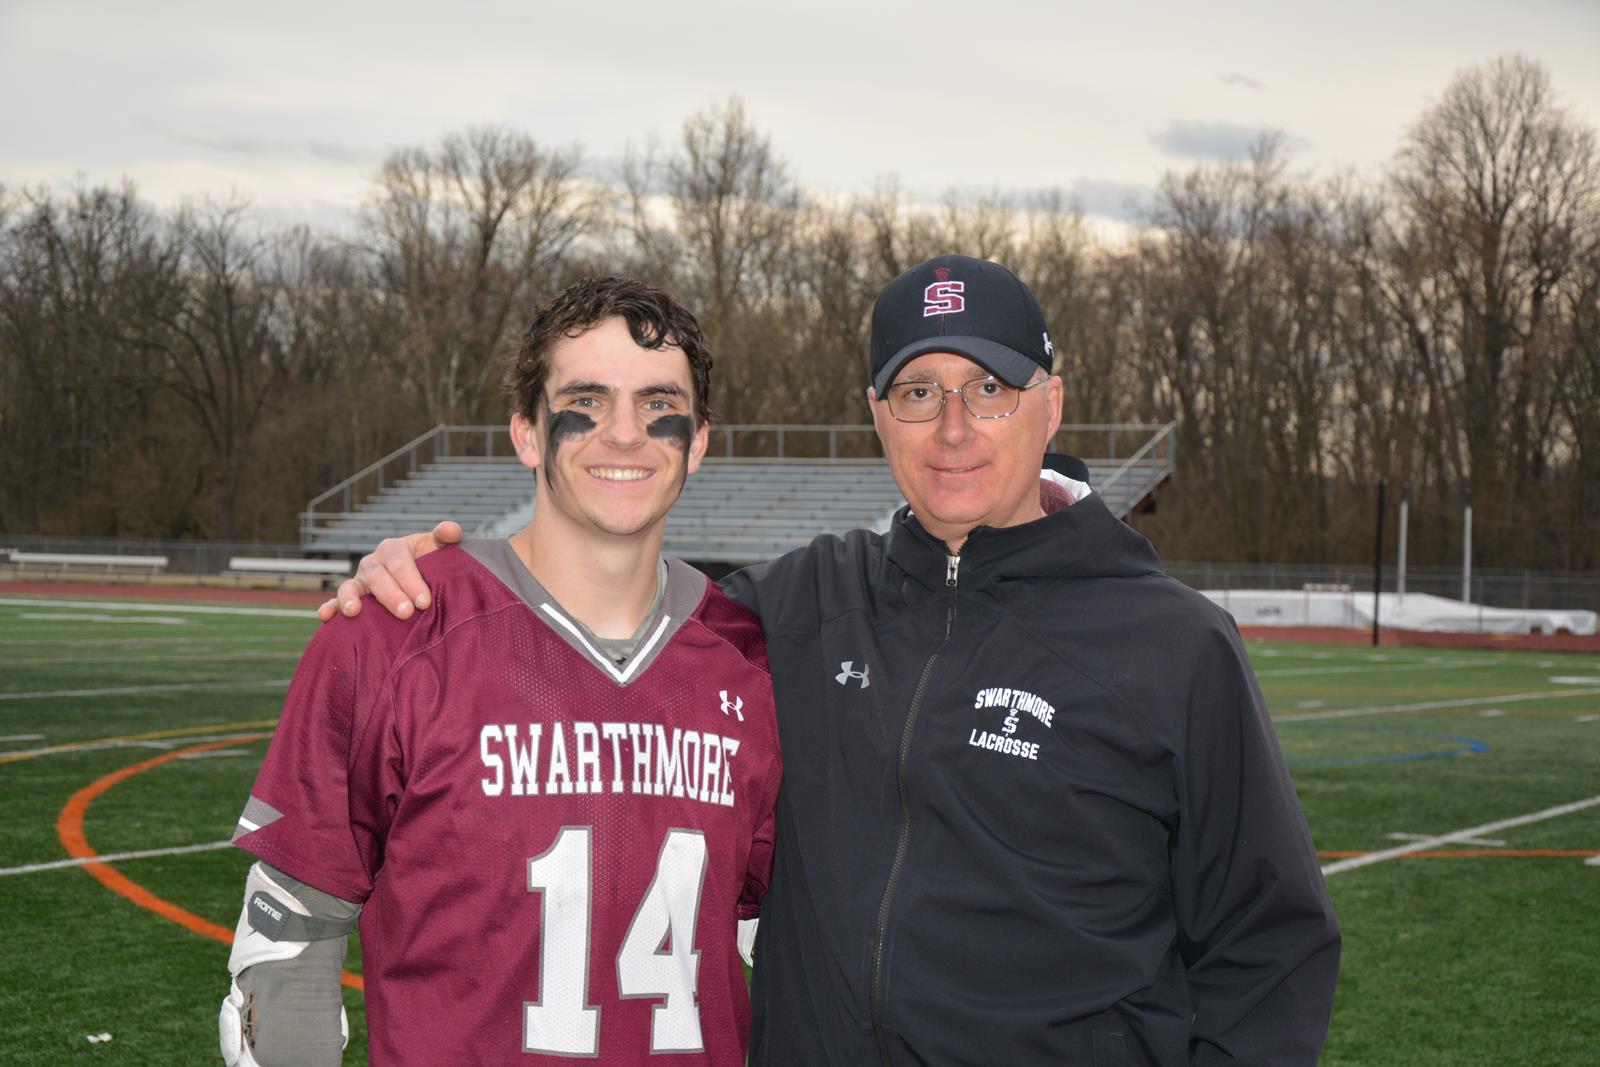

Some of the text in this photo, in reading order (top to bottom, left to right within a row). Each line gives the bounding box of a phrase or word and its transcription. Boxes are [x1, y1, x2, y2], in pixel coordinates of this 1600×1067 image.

[923, 281, 965, 317] S
[974, 687, 1055, 728] SWARTHMORE
[1001, 716, 1020, 734] S
[969, 728, 1040, 761] LACROSSE
[480, 721, 740, 807] SWARTHMORE
[253, 896, 283, 921] ROME
[522, 824, 709, 1058] 14
